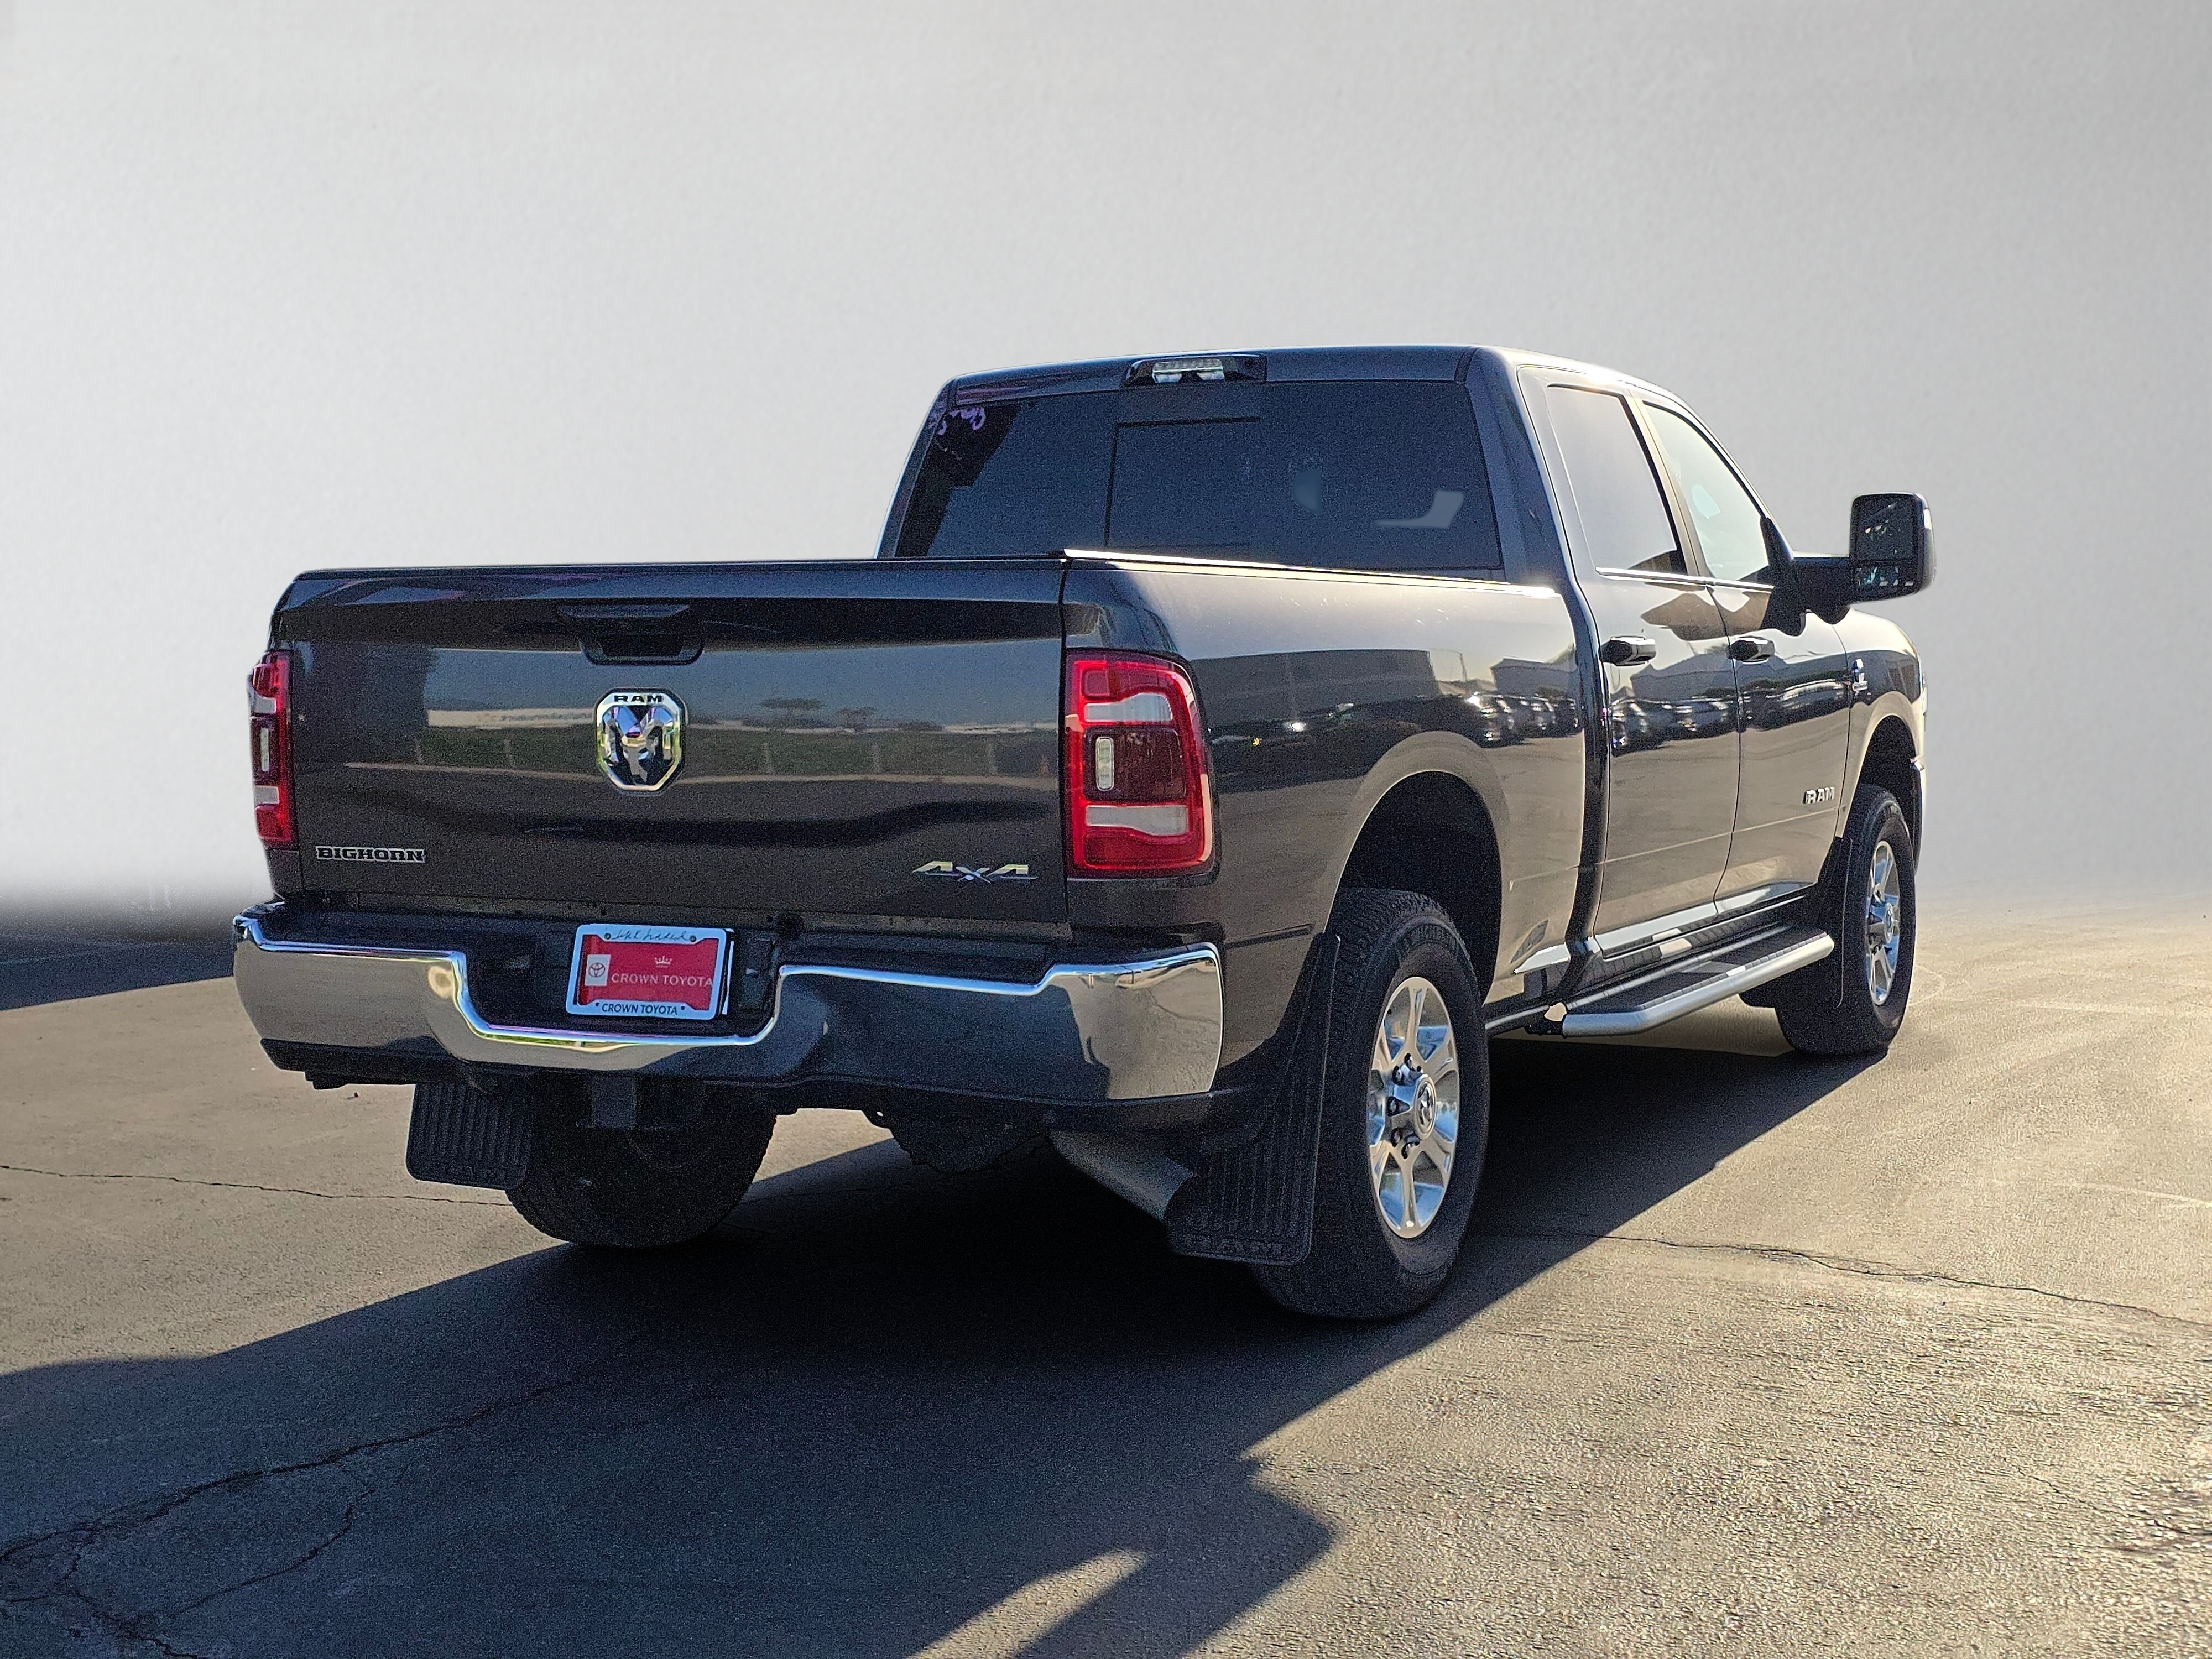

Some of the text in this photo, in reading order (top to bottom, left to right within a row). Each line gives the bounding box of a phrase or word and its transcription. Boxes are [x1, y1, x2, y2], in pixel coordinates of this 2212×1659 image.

[1804, 787, 1835, 804] RAM
[316, 846, 426, 863] BIGHORN
[612, 973, 713, 988] CROWN TOYOTA
[602, 1003, 677, 1015] CROWN TOYOTA
